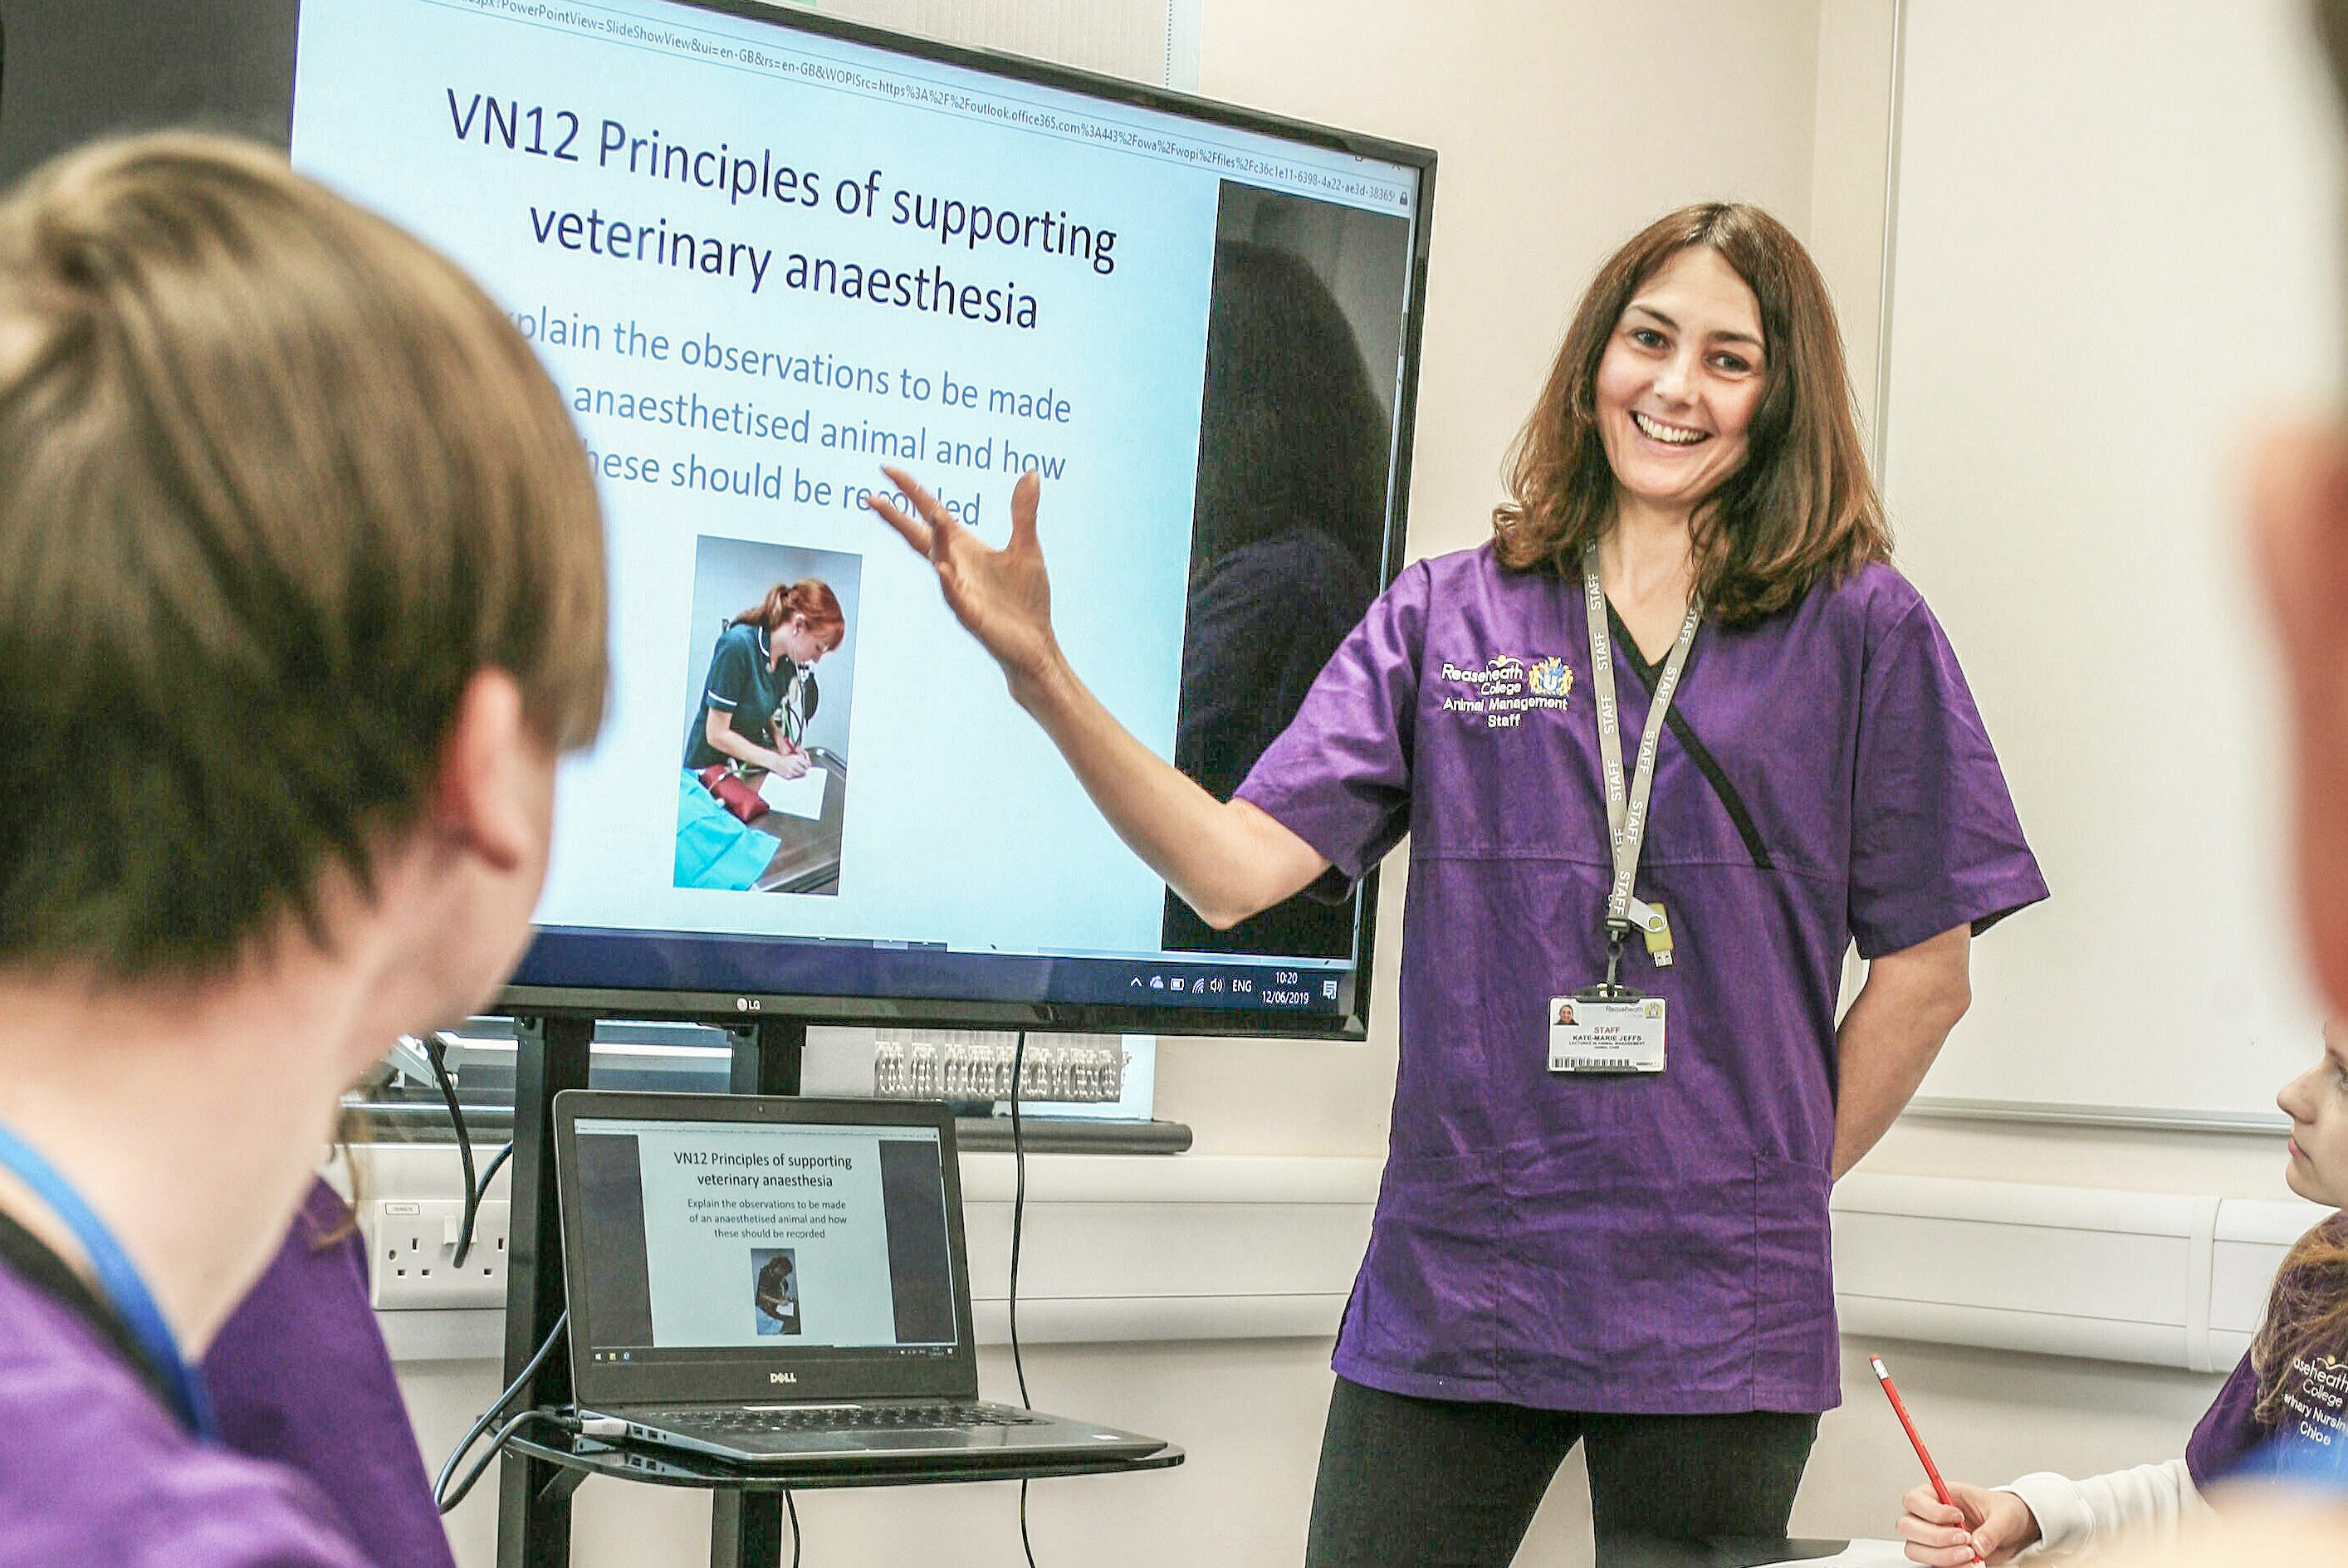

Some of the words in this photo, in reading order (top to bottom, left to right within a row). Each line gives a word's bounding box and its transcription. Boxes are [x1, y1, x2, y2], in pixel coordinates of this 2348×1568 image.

[448, 89, 578, 161] VN12
[596, 120, 819, 208] Principles
[836, 170, 881, 217] of
[893, 189, 1117, 275] supporting
[531, 208, 771, 293] veterinary
[786, 254, 1036, 328] anaesthesia
[509, 305, 600, 351] plain
[614, 321, 668, 359] the
[681, 334, 889, 395] observations
[900, 369, 930, 400] to
[942, 371, 977, 408] be
[990, 388, 1070, 423] made
[573, 387, 810, 444] anaesthetised
[821, 420, 925, 460] animal
[937, 437, 991, 469] and
[1003, 440, 1066, 481] how
[583, 437, 660, 483] hese
[672, 454, 781, 500] should
[794, 466, 832, 506] be
[1587, 573, 1602, 610] STAFF
[1593, 632, 1608, 671] STAFF
[1441, 662, 1524, 683] Reaseheath
[1481, 681, 1522, 696] College
[1657, 666, 1678, 706] STAFF
[1442, 696, 1485, 712] Animal
[1489, 696, 1568, 711] Management
[1600, 694, 1615, 735] STAFF
[1487, 714, 1521, 728] Staff
[1640, 730, 1656, 774] STAFF
[1607, 759, 1622, 802] STAFF
[1627, 800, 1643, 846] STAFF
[1614, 870, 1631, 916] STAFF
[1232, 979, 1252, 993] ENG
[1275, 971, 1298, 984] 10:20
[1262, 989, 1309, 1004] 12/06/2019
[1594, 1026, 1620, 1034] STAFF
[673, 1151, 707, 1165] VN12
[712, 1152, 770, 1169] Principles
[773, 1153, 785, 1166] of
[788, 1154, 852, 1170] supporting
[697, 1174, 759, 1189] veterinary
[763, 1175, 833, 1187] anaesthesia
[687, 1199, 720, 1208] Explain
[722, 1199, 736, 1208] the
[739, 1200, 795, 1209] observations
[809, 1201, 819, 1209] be
[822, 1201, 846, 1209] made
[689, 1214, 698, 1223] of
[714, 1214, 775, 1224] anaesthetised
[778, 1214, 807, 1224] animal
[810, 1214, 825, 1224] and
[829, 1215, 847, 1224] how
[714, 1229, 739, 1238] these
[741, 1229, 770, 1238] should
[773, 1229, 784, 1238] be
[786, 1229, 825, 1238] recorded
[770, 1372, 797, 1384] DELL
[2293, 1356, 2348, 1394] aseheath
[2302, 1379, 2343, 1407] College
[2281, 1394, 2311, 1418] erinary
[2300, 1420, 2331, 1445] Chloe
